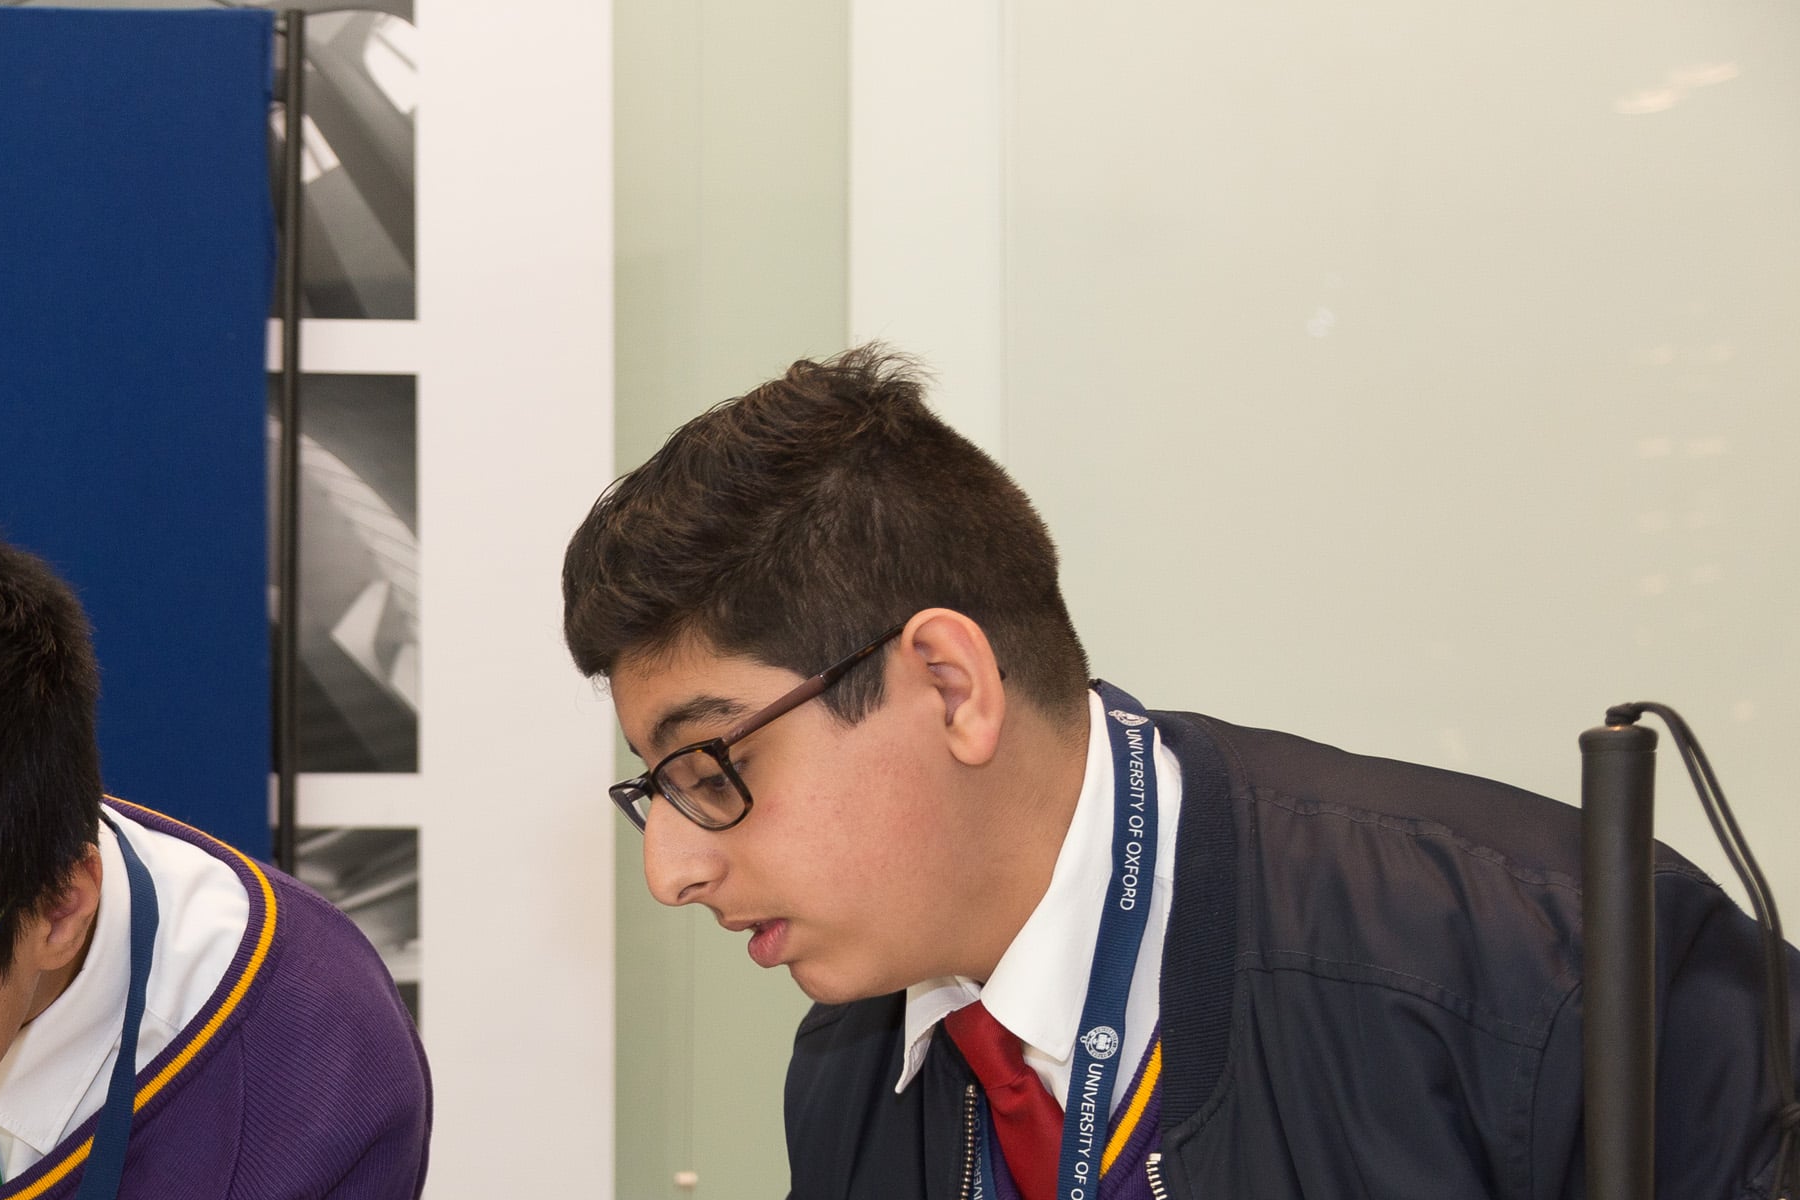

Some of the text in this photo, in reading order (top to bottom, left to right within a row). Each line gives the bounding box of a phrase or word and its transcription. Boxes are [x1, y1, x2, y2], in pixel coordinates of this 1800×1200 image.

[1120, 729, 1144, 911] UNIVERSITY OF OXFORD
[1079, 1063, 1104, 1158] UNIVERSITY
[1074, 1161, 1089, 1184] OF
